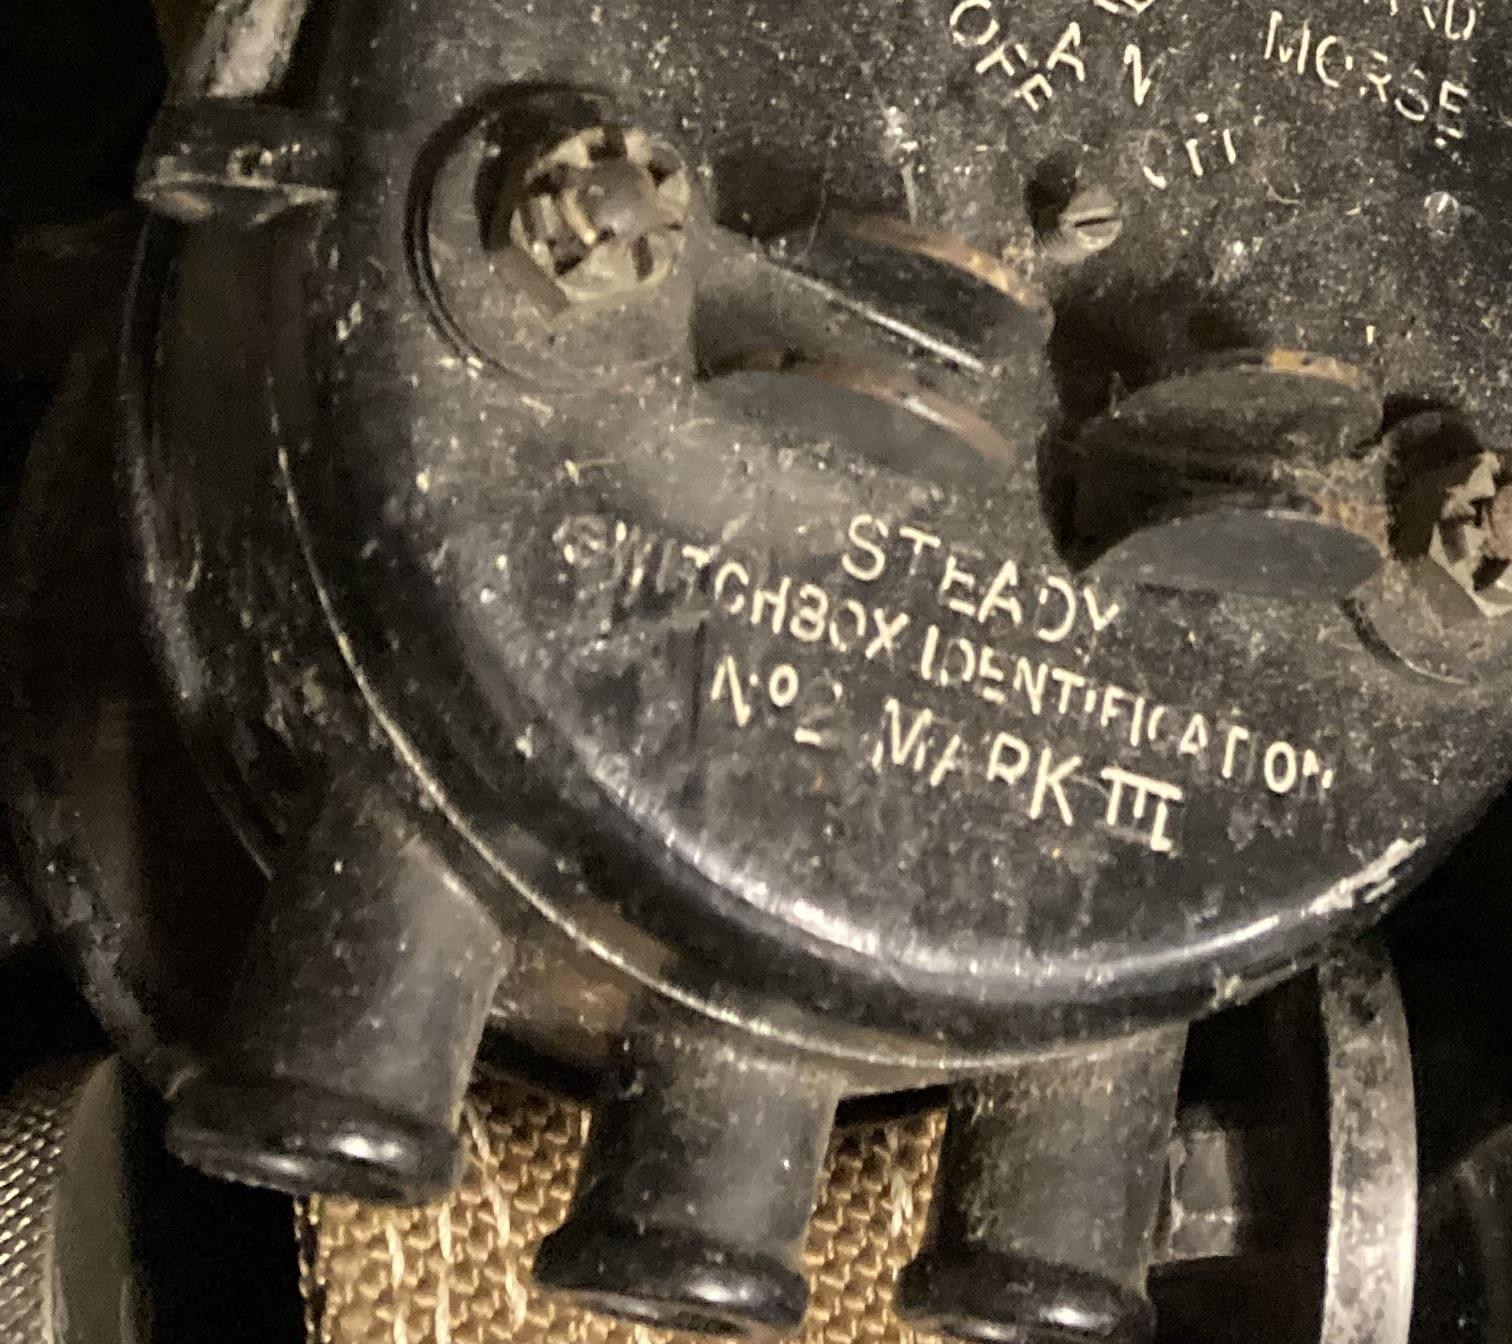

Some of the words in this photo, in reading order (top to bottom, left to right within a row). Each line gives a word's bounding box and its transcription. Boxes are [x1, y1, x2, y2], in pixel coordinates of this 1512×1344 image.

[1264, 11, 1470, 140] MORSE
[842, 515, 1119, 642] STEADY
[873, 699, 1082, 825] MARK
[920, 625, 1334, 795] IDENTIFICATION
